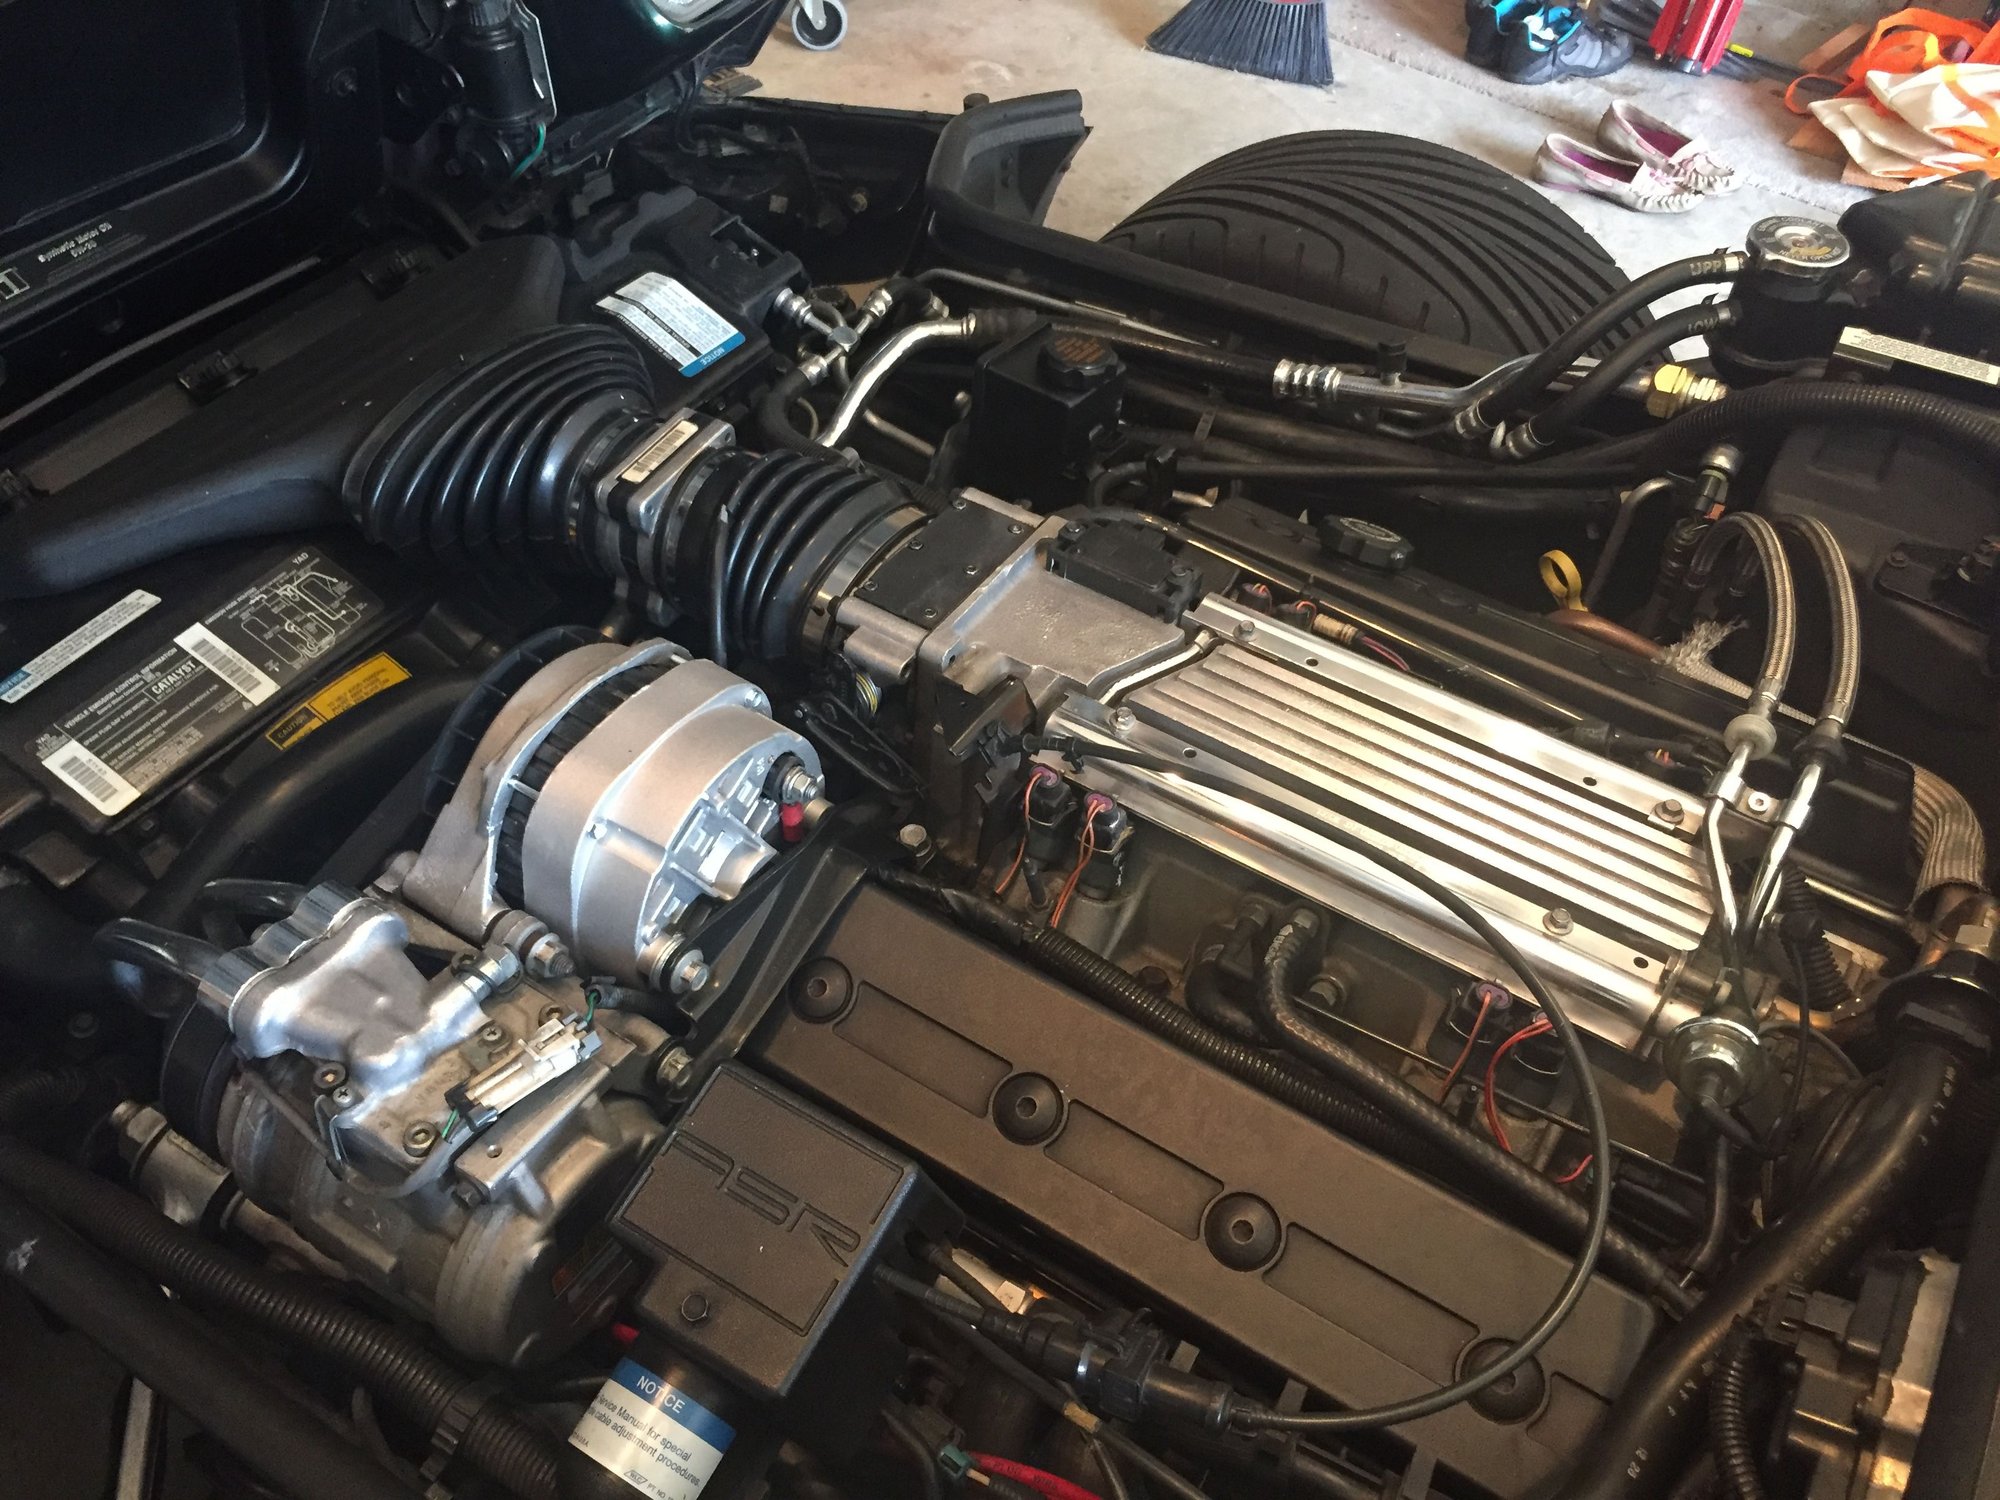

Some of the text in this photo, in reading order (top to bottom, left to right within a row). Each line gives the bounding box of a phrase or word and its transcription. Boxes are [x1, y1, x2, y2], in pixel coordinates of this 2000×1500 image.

[699, 346, 725, 367] NOTICE
[150, 660, 197, 695] CATALYST
[635, 1375, 686, 1414] NOTICE
[594, 1410, 703, 1488] cable adjustment procedures.
[616, 1406, 648, 1432] Manual
[646, 1426, 662, 1441] for
[658, 1435, 692, 1464] special
